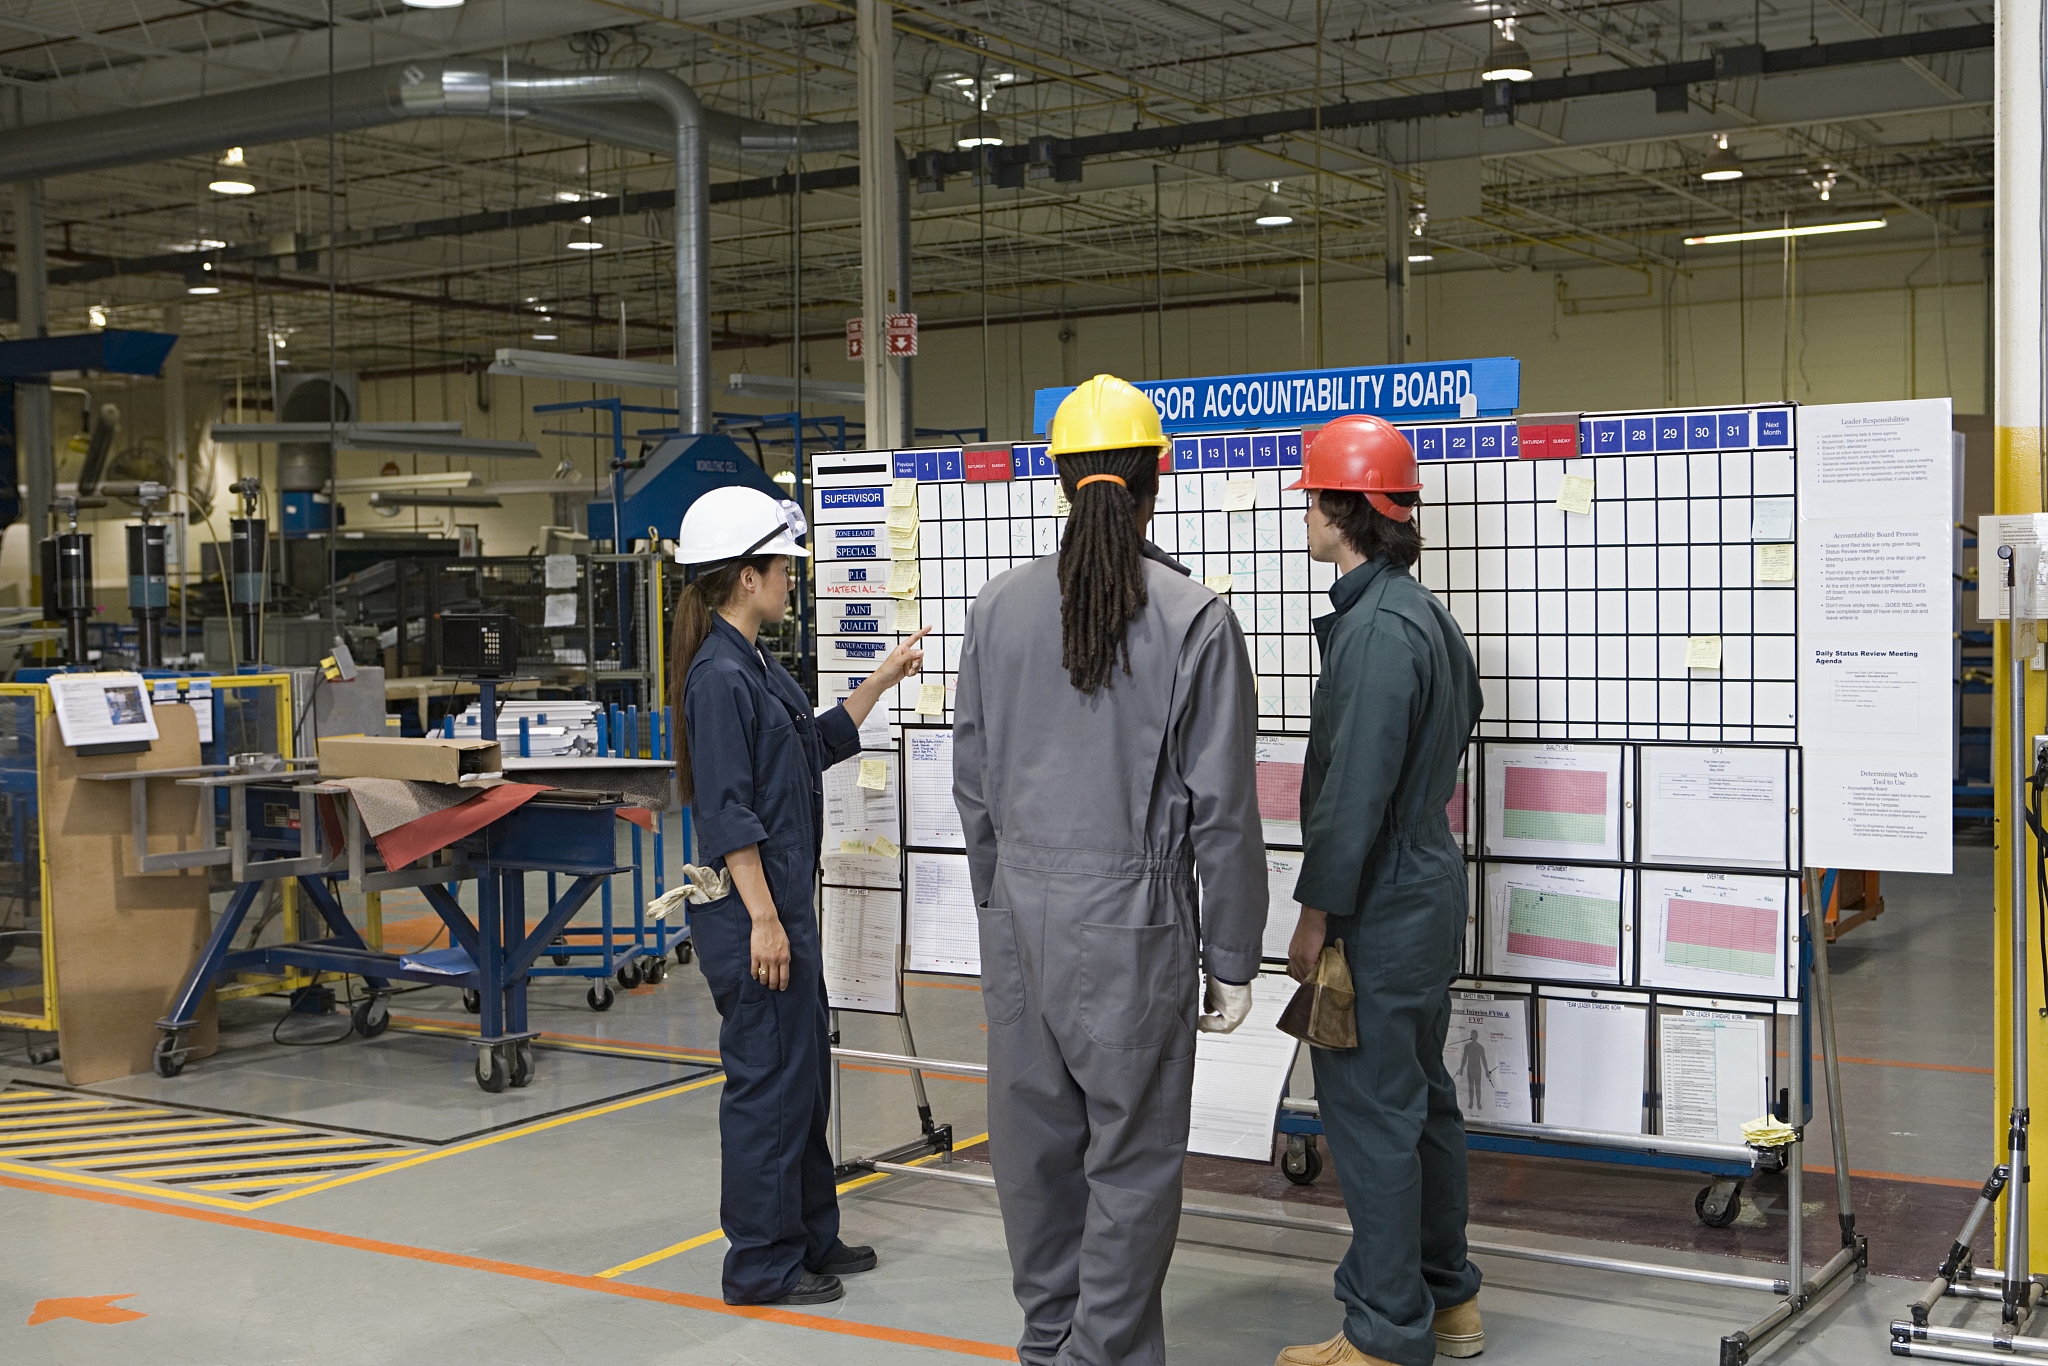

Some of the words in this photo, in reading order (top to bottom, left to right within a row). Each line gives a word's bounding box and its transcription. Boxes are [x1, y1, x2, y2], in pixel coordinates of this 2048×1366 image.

[1203, 374, 1385, 418] ACCOUNTABILITY
[1393, 369, 1471, 408] BOARD
[1862, 416, 1910, 424] Responsibilities
[1632, 430, 1646, 440] 28
[1663, 428, 1678, 438] 29
[1694, 428, 1710, 438] 30
[1726, 426, 1740, 436] 31
[1482, 437, 1495, 446] 23
[1512, 436, 1518, 446] 2
[1601, 432, 1614, 442] 27
[1424, 440, 1435, 449] 21
[1452, 438, 1466, 448] 22
[1182, 450, 1192, 460] 12
[1208, 448, 1219, 458] 13
[1234, 448, 1244, 458] 14
[1260, 446, 1270, 456] 15
[1286, 446, 1298, 456] 16
[726, 461, 738, 472] CELL
[925, 462, 929, 471] 1
[946, 462, 952, 470] 2
[1016, 458, 1020, 467] 5
[1040, 457, 1045, 466] 6
[824, 493, 880, 504] SUPERVISOR
[836, 547, 876, 556] SPECIALS
[848, 570, 866, 580] P.I.C
[846, 606, 871, 614] PAINT
[840, 622, 878, 632] QUALITY
[836, 642, 886, 650] MANUFACTURING
